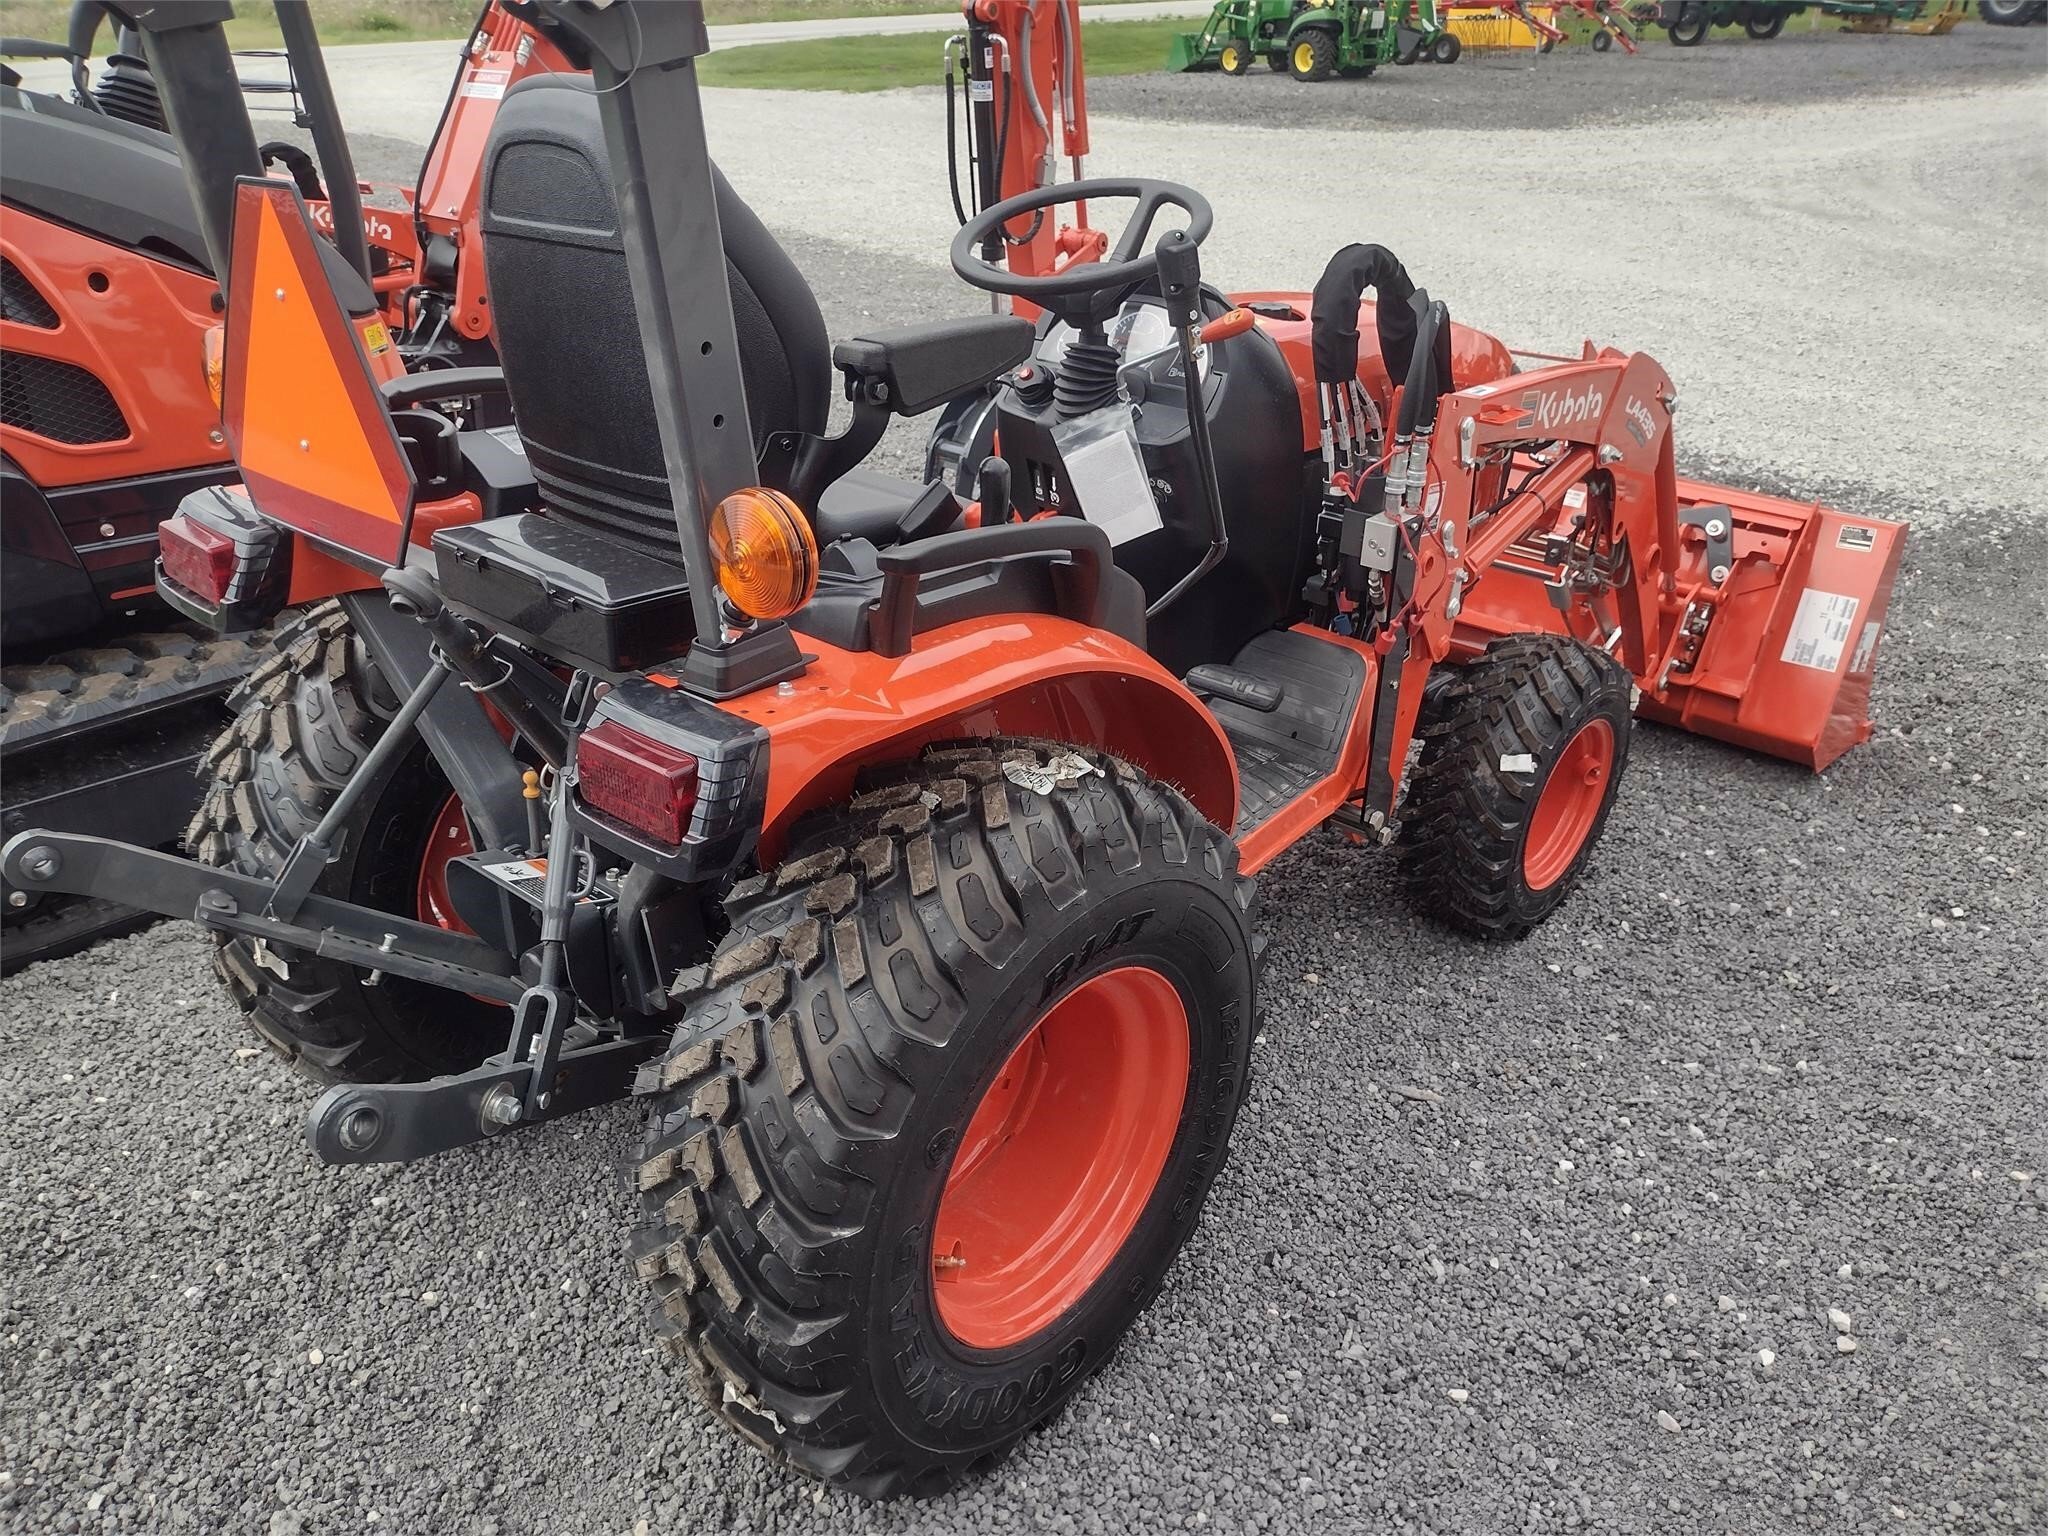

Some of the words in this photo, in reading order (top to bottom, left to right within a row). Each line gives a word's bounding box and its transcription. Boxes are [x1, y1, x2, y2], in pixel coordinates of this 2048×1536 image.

[1538, 383, 1603, 429] Kubota
[1624, 395, 1657, 440] LA435
[888, 1221, 1087, 1429] GOODYEAR
